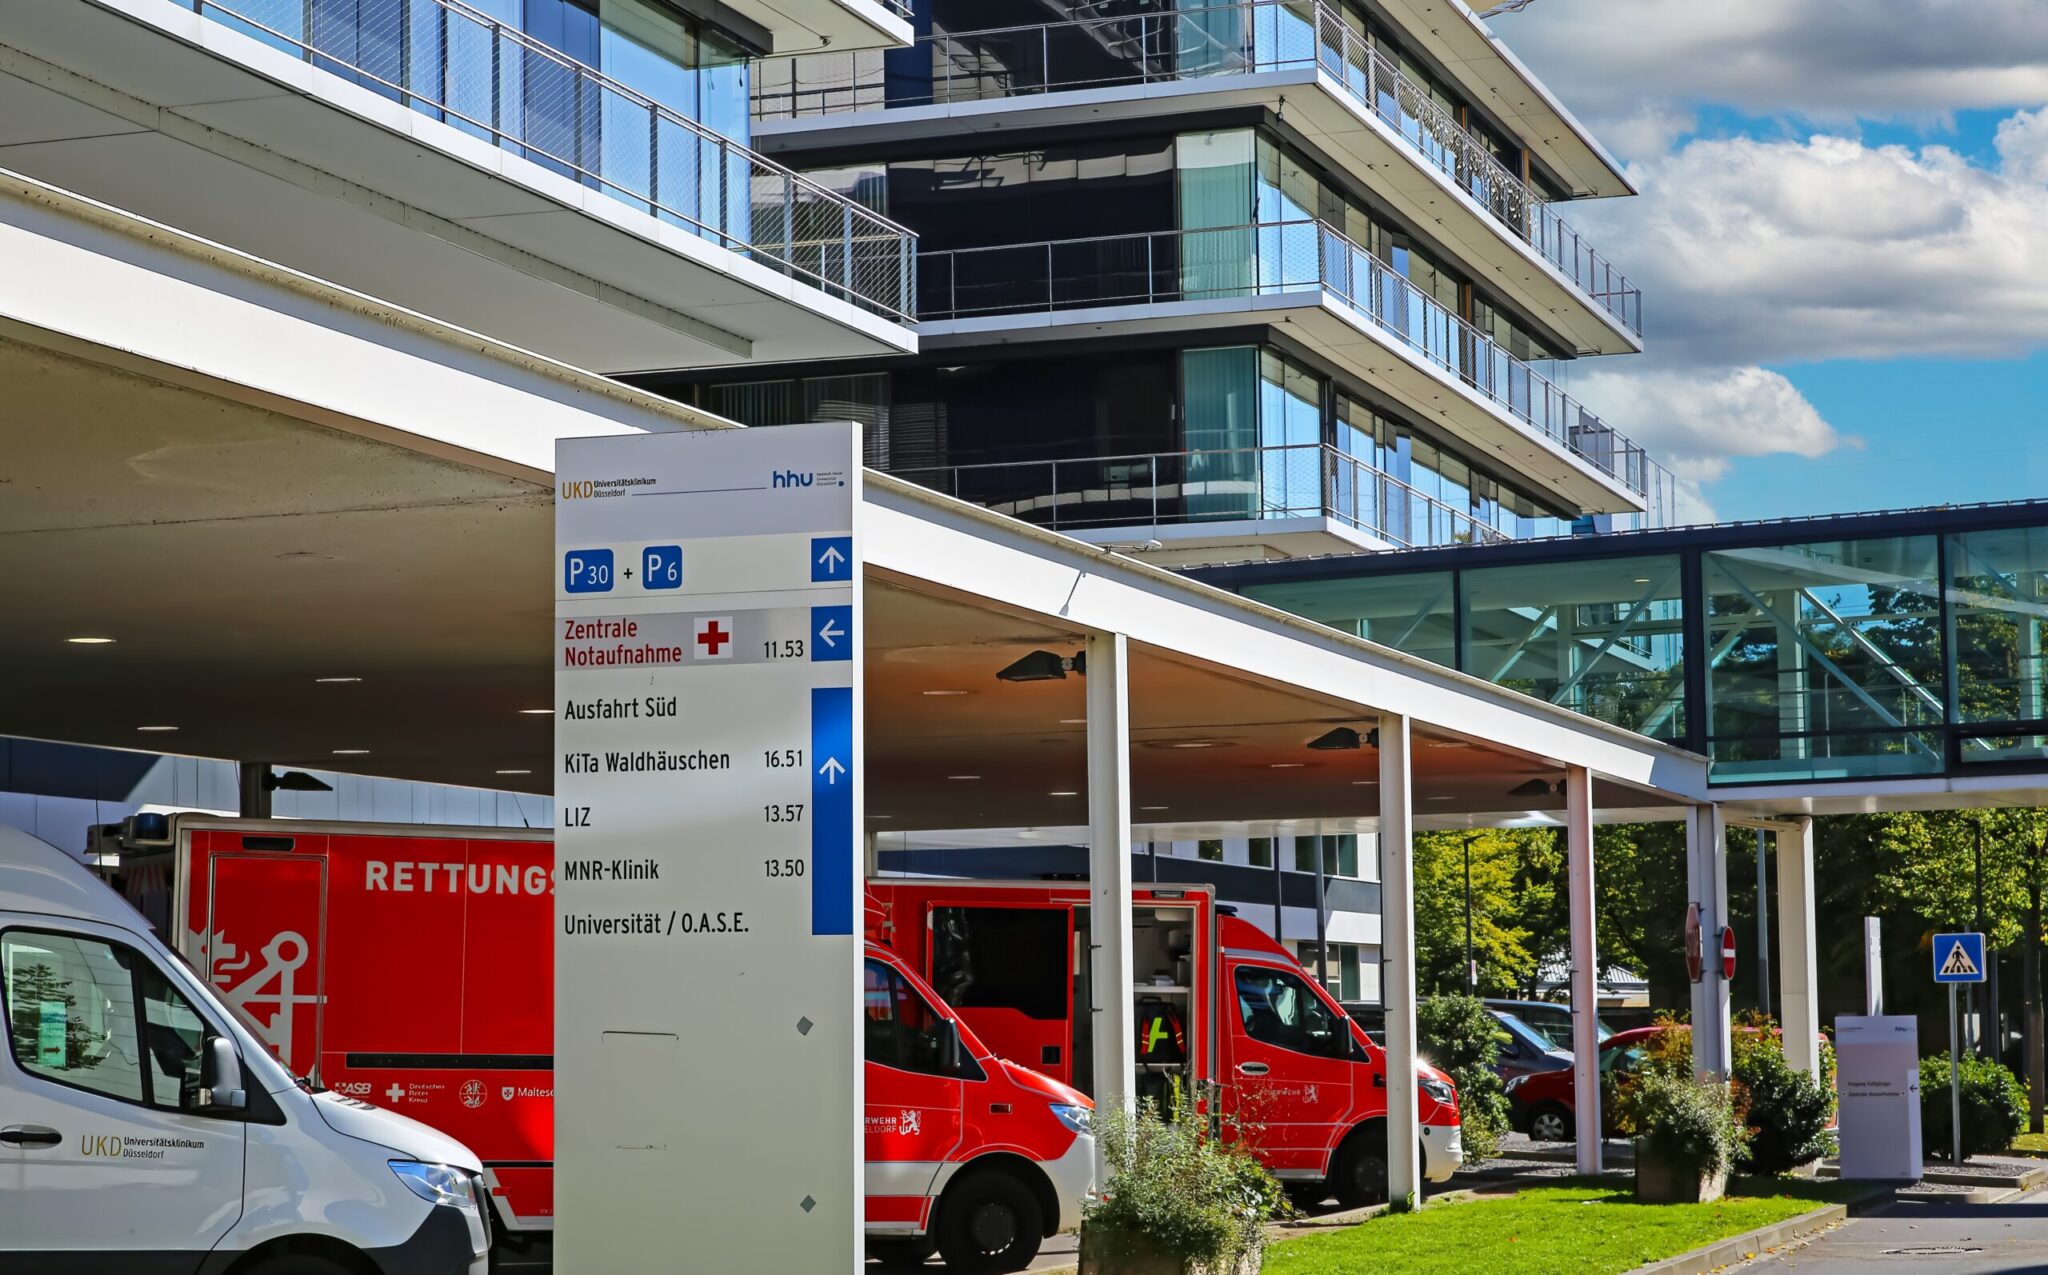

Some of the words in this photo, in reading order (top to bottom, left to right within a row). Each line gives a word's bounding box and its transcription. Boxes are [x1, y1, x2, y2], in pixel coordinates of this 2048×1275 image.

[563, 481, 593, 499] UKD
[594, 478, 656, 488] Universitätsklinikum
[773, 470, 813, 488] hhu
[592, 487, 625, 498] Düsseldorf
[565, 618, 637, 639] Zentrale
[566, 644, 681, 666] Notaufnahme
[764, 640, 803, 658] 11.53
[565, 698, 638, 719] Ausfahrt
[646, 697, 676, 717] Süd
[566, 753, 598, 773] KiTa
[606, 750, 729, 772] Waldhäuschen
[765, 750, 802, 767] 16.51
[565, 807, 590, 827] LIZ
[765, 805, 803, 822] 13.57
[365, 860, 554, 896] RETTUNG
[565, 859, 658, 880] MNR-Klinik
[765, 859, 804, 877] 13.50
[565, 914, 661, 934] Universität
[667, 911, 676, 935] /
[682, 912, 748, 933] O.A.S.E.
[345, 1082, 372, 1095] ASB
[81, 1135, 122, 1157] UKD
[124, 1137, 205, 1149] Universitätsklinikum
[123, 1148, 165, 1159] Düsseldorf
